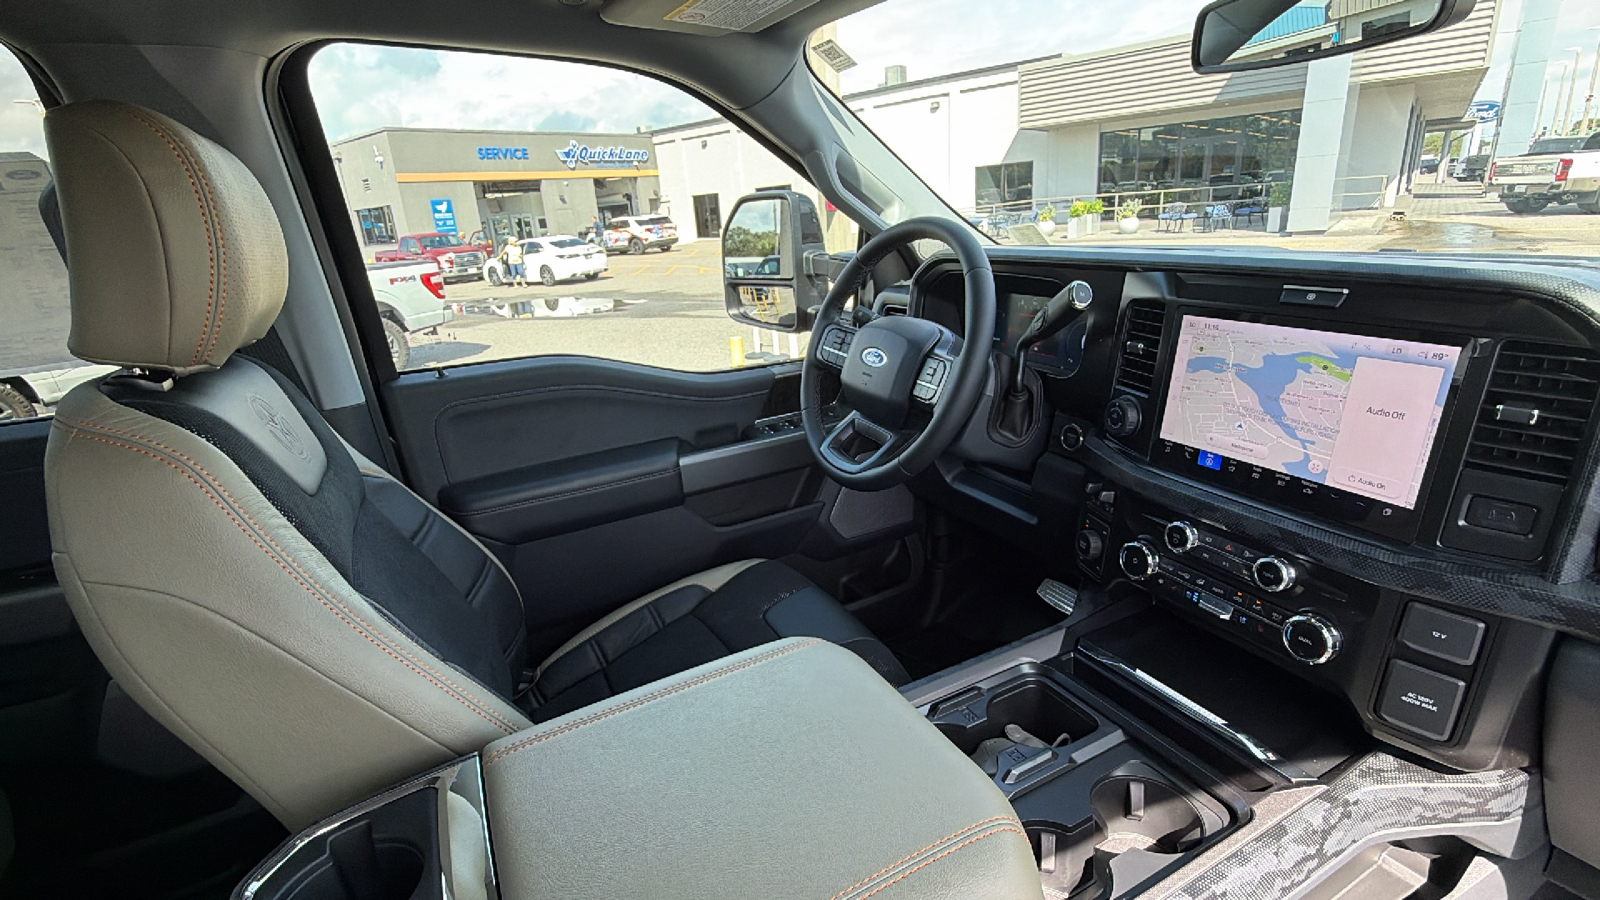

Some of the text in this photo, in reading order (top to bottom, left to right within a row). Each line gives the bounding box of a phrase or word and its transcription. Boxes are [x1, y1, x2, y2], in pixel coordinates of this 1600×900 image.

[477, 146, 529, 160] SERVICE
[1366, 406, 1406, 421] Audio Off
[1358, 477, 1386, 490] Audio On
[1432, 630, 1440, 638] 12
[1407, 691, 1417, 699] AC
[1400, 695, 1438, 712] 400W MAX
